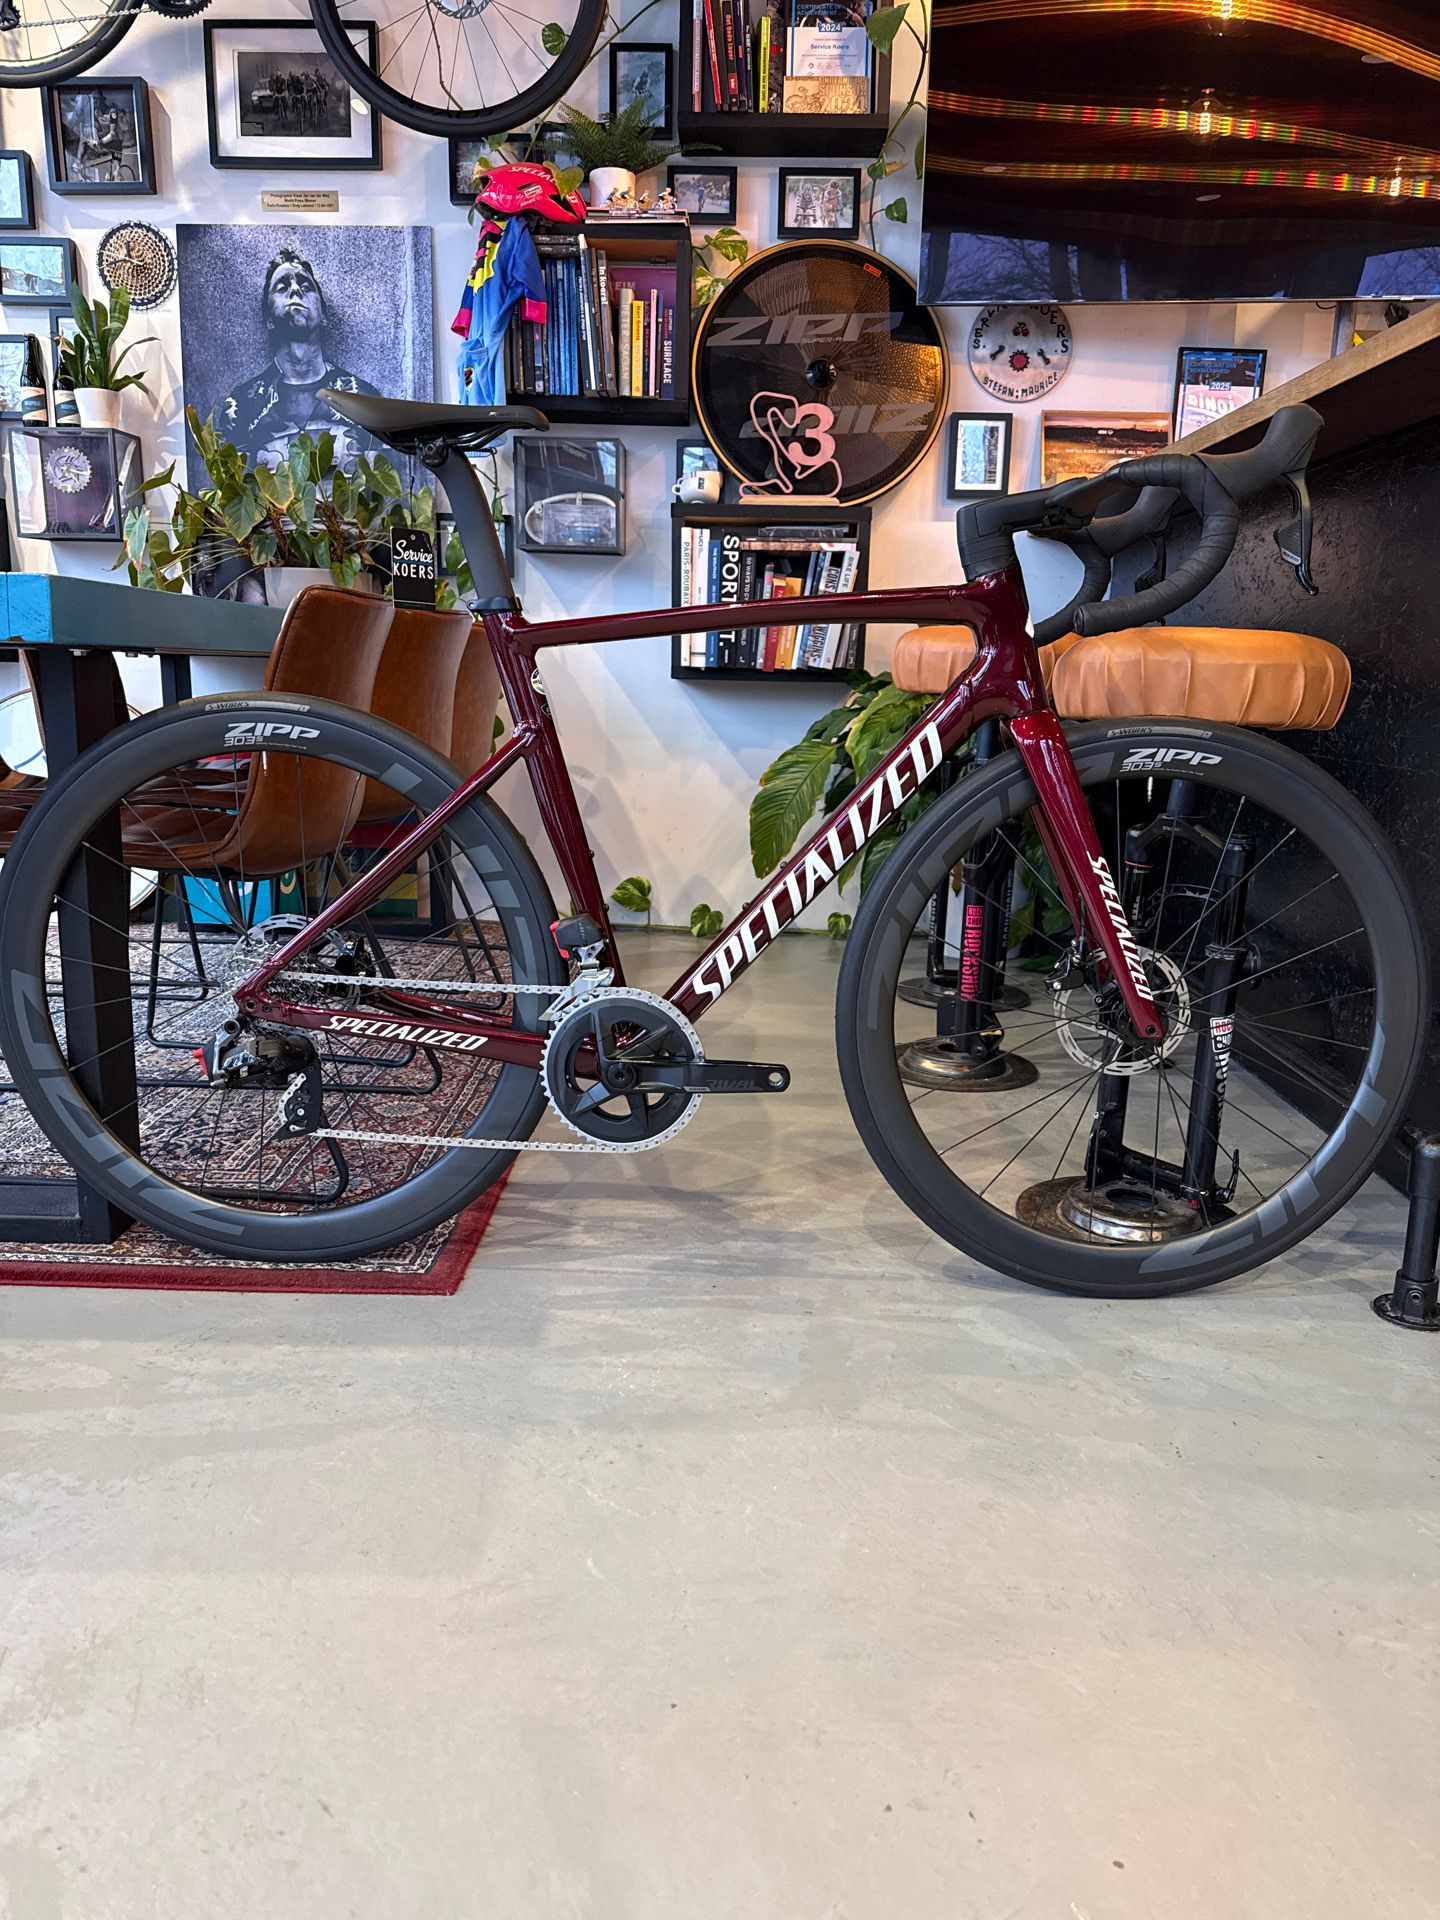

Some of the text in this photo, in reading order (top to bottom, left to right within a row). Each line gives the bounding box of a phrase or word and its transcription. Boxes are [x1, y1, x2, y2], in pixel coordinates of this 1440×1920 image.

[820, 23, 841, 31] 2024
[820, 95, 868, 113] 2024
[599, 266, 609, 305] In koers!
[706, 311, 904, 347] ZIPP
[621, 304, 630, 379] PETER SAGAN
[663, 340, 673, 384] SURPLACE
[1210, 382, 1230, 391] 2025
[393, 540, 434, 563] Service
[848, 556, 856, 570] BIKE
[393, 562, 434, 580] KOERS
[682, 541, 690, 605] PARIS-ROUBAIX
[744, 565, 752, 584] WAYS
[224, 722, 320, 740] ZIPP
[1122, 747, 1223, 766] ZIPP
[692, 721, 944, 1008] SPECIALIZED
[1086, 850, 1154, 1001] SPECIALIZED
[320, 1015, 489, 1051] SPECIALIZED
